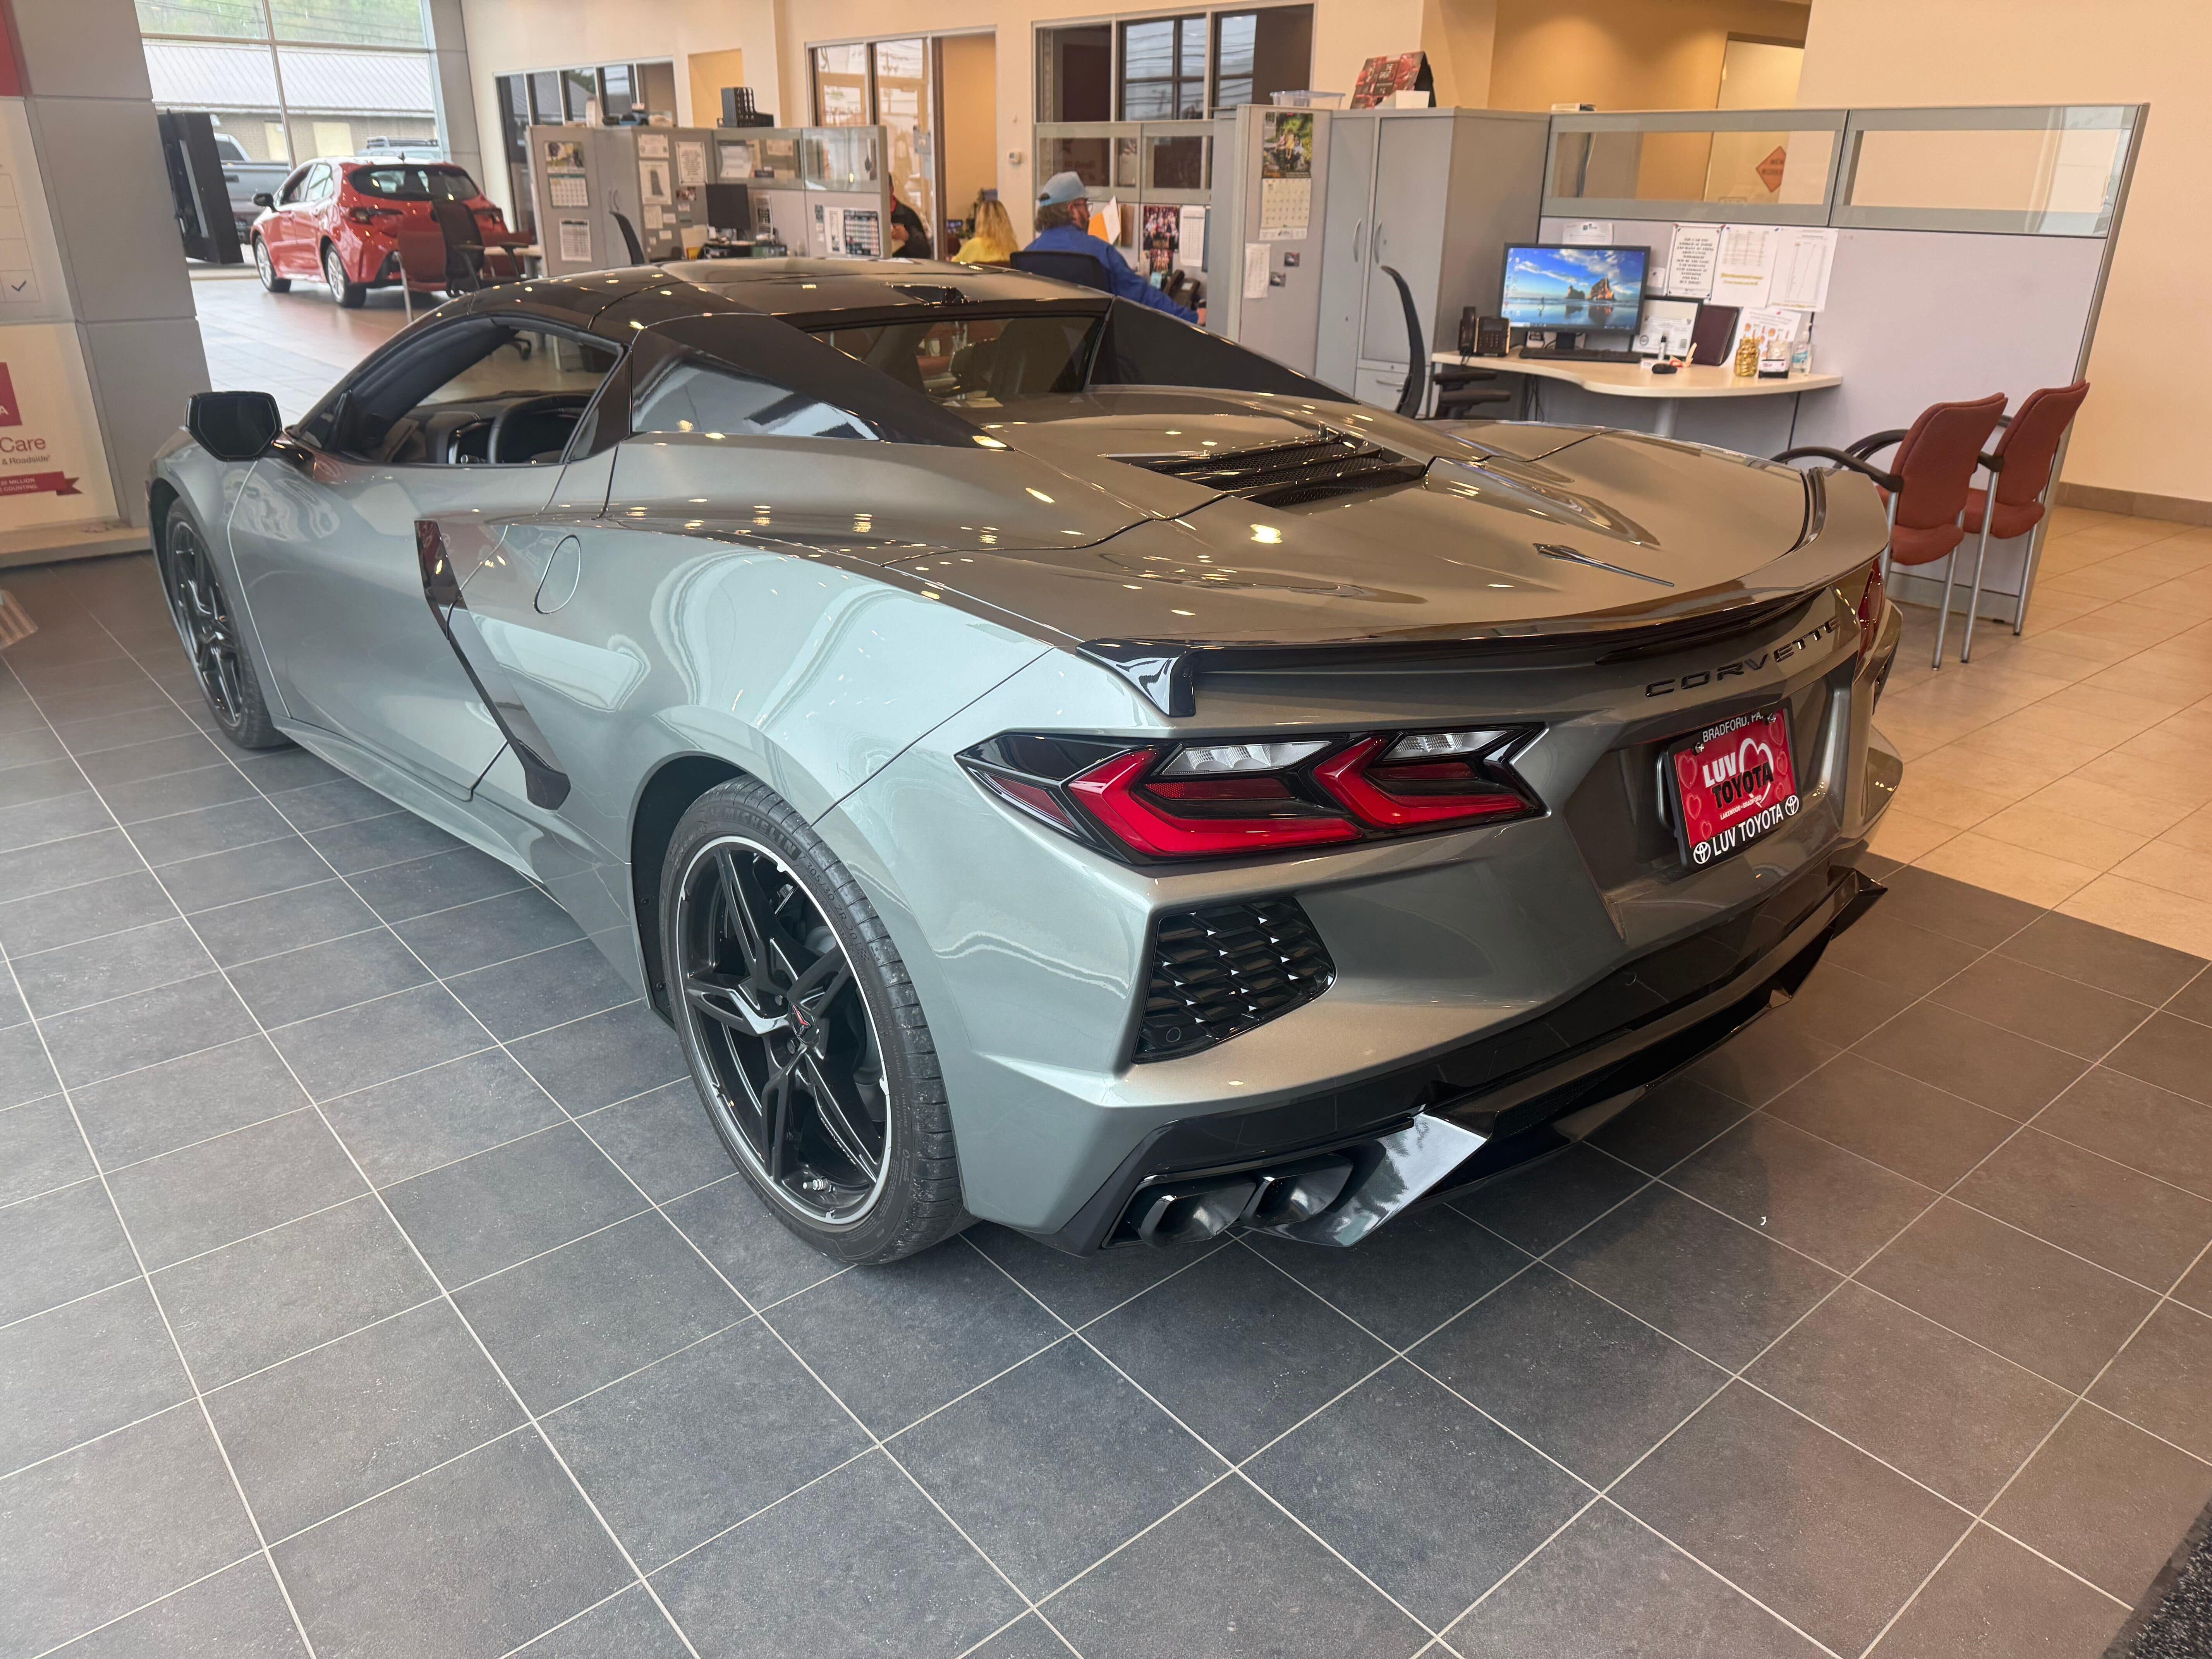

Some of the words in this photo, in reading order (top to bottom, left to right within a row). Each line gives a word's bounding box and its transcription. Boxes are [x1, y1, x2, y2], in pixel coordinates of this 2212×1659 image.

[1645, 617, 1841, 697] CORVETTE
[1703, 716, 1750, 743] BRADFORD,
[1751, 711, 1764, 723] PA.
[1702, 752, 1737, 788] LUV
[1712, 762, 1774, 809] TOYOTA
[725, 807, 798, 859] MICHELIN
[1712, 826, 1736, 856] LUV
[1738, 803, 1784, 842] TOYOTA
[805, 862, 835, 901] 305/30
[848, 926, 857, 940] 20
